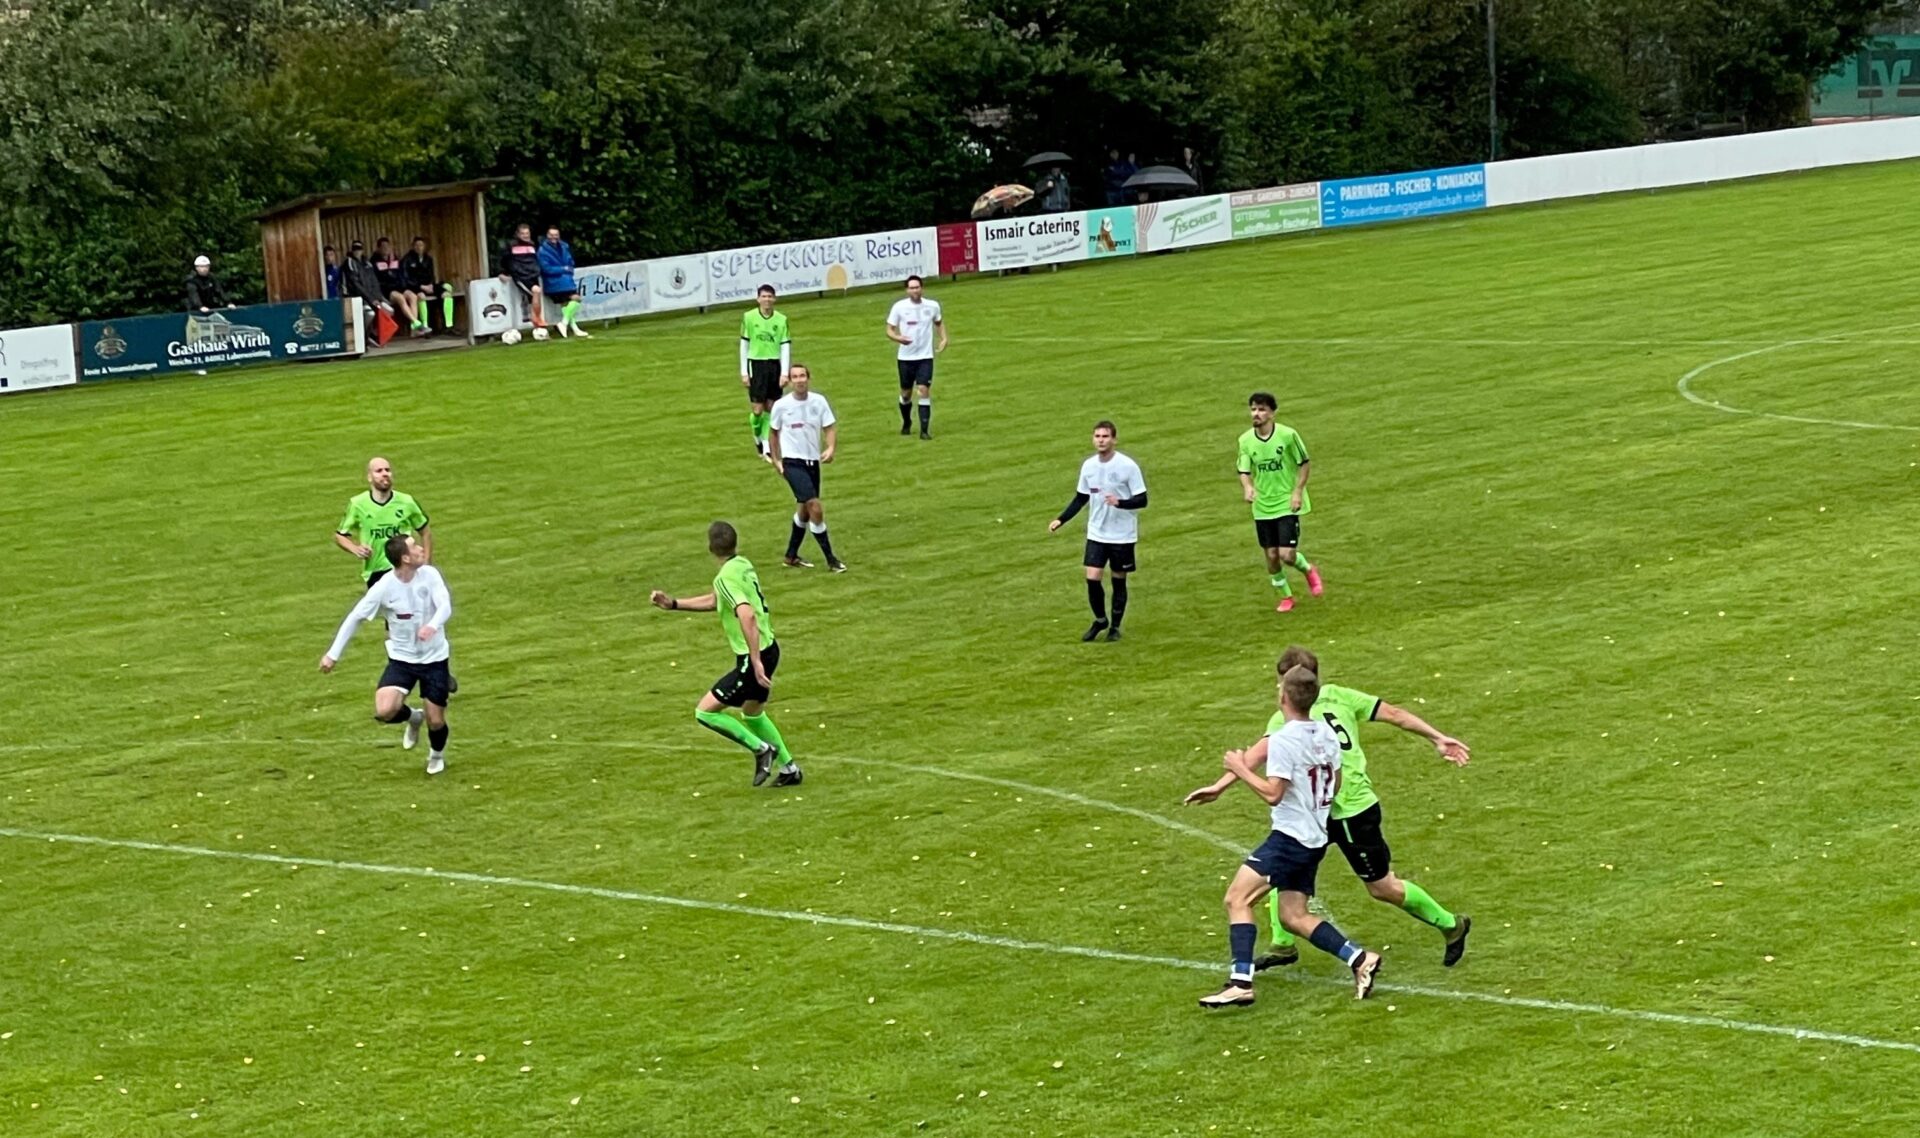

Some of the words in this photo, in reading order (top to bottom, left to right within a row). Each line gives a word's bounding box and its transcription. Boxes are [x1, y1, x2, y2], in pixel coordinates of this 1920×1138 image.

[1340, 182, 1390, 201] PARRINGER
[1395, 177, 1431, 196] FISCHER
[985, 222, 1024, 241] Ismair
[1028, 217, 1080, 236] Catering
[711, 239, 855, 278] SPECKNER
[866, 237, 922, 260] Reisen
[167, 339, 228, 357] Gasthaus
[230, 331, 271, 349] Wirth
[370, 526, 401, 540] FRICK
[1307, 761, 1334, 812] 12
